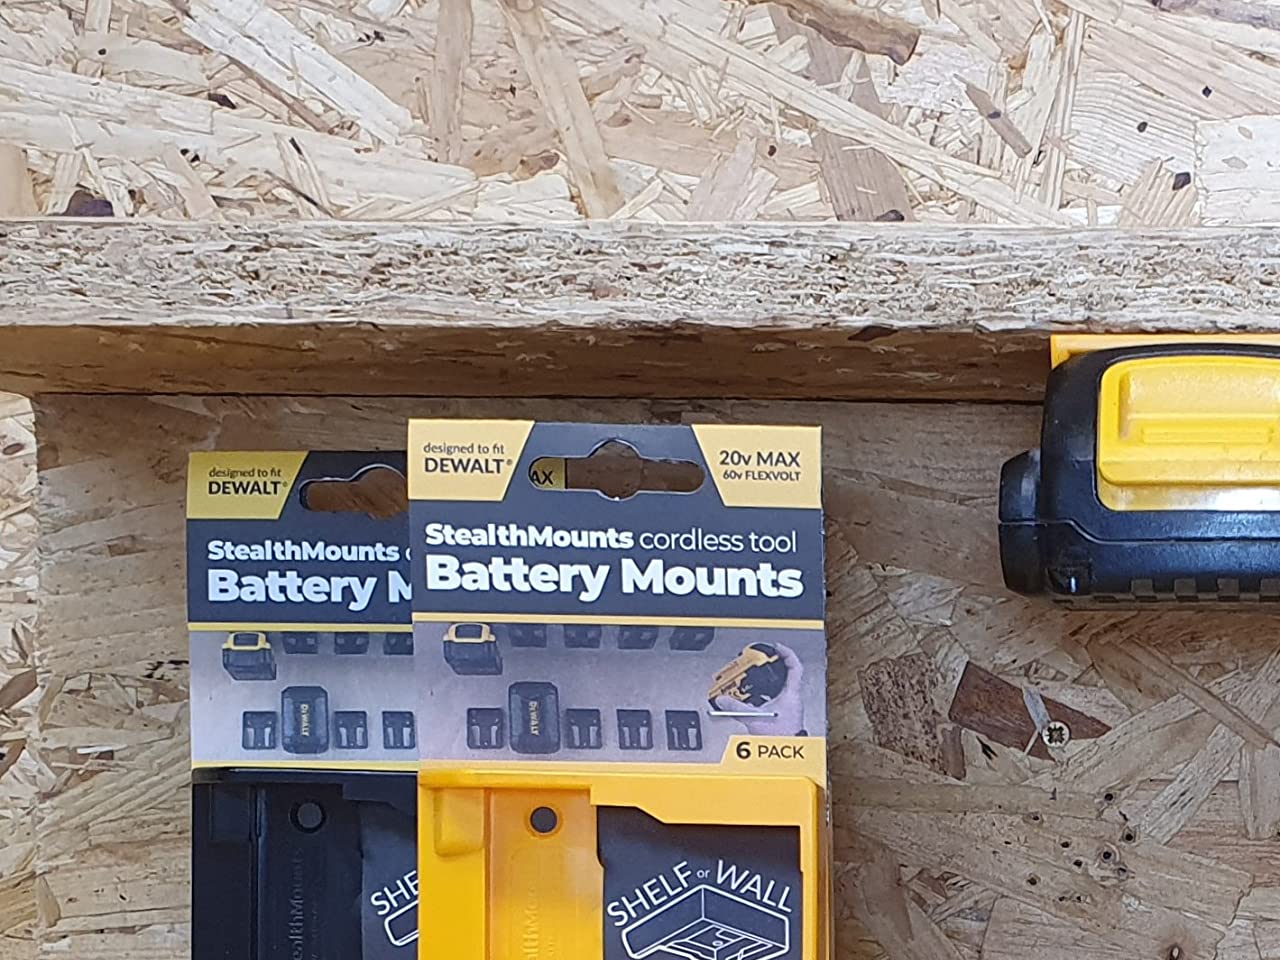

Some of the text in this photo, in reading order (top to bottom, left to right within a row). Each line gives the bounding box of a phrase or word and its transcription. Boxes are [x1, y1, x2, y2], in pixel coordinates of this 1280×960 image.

[424, 442, 505, 456] designed to fit
[756, 450, 801, 468] MAX
[208, 466, 282, 479] designed to fit
[532, 471, 554, 486] AX
[745, 470, 801, 482] FLEXVOLT
[425, 522, 797, 553] StealthMounts cordless tool
[207, 539, 400, 561] StealthMounts
[425, 554, 611, 603] Battery
[620, 557, 805, 598] Mounts
[207, 568, 378, 612] Battery
[736, 741, 805, 760] 6 PACK
[370, 869, 419, 916] SHE
[606, 859, 793, 927] SHELF or WALL
